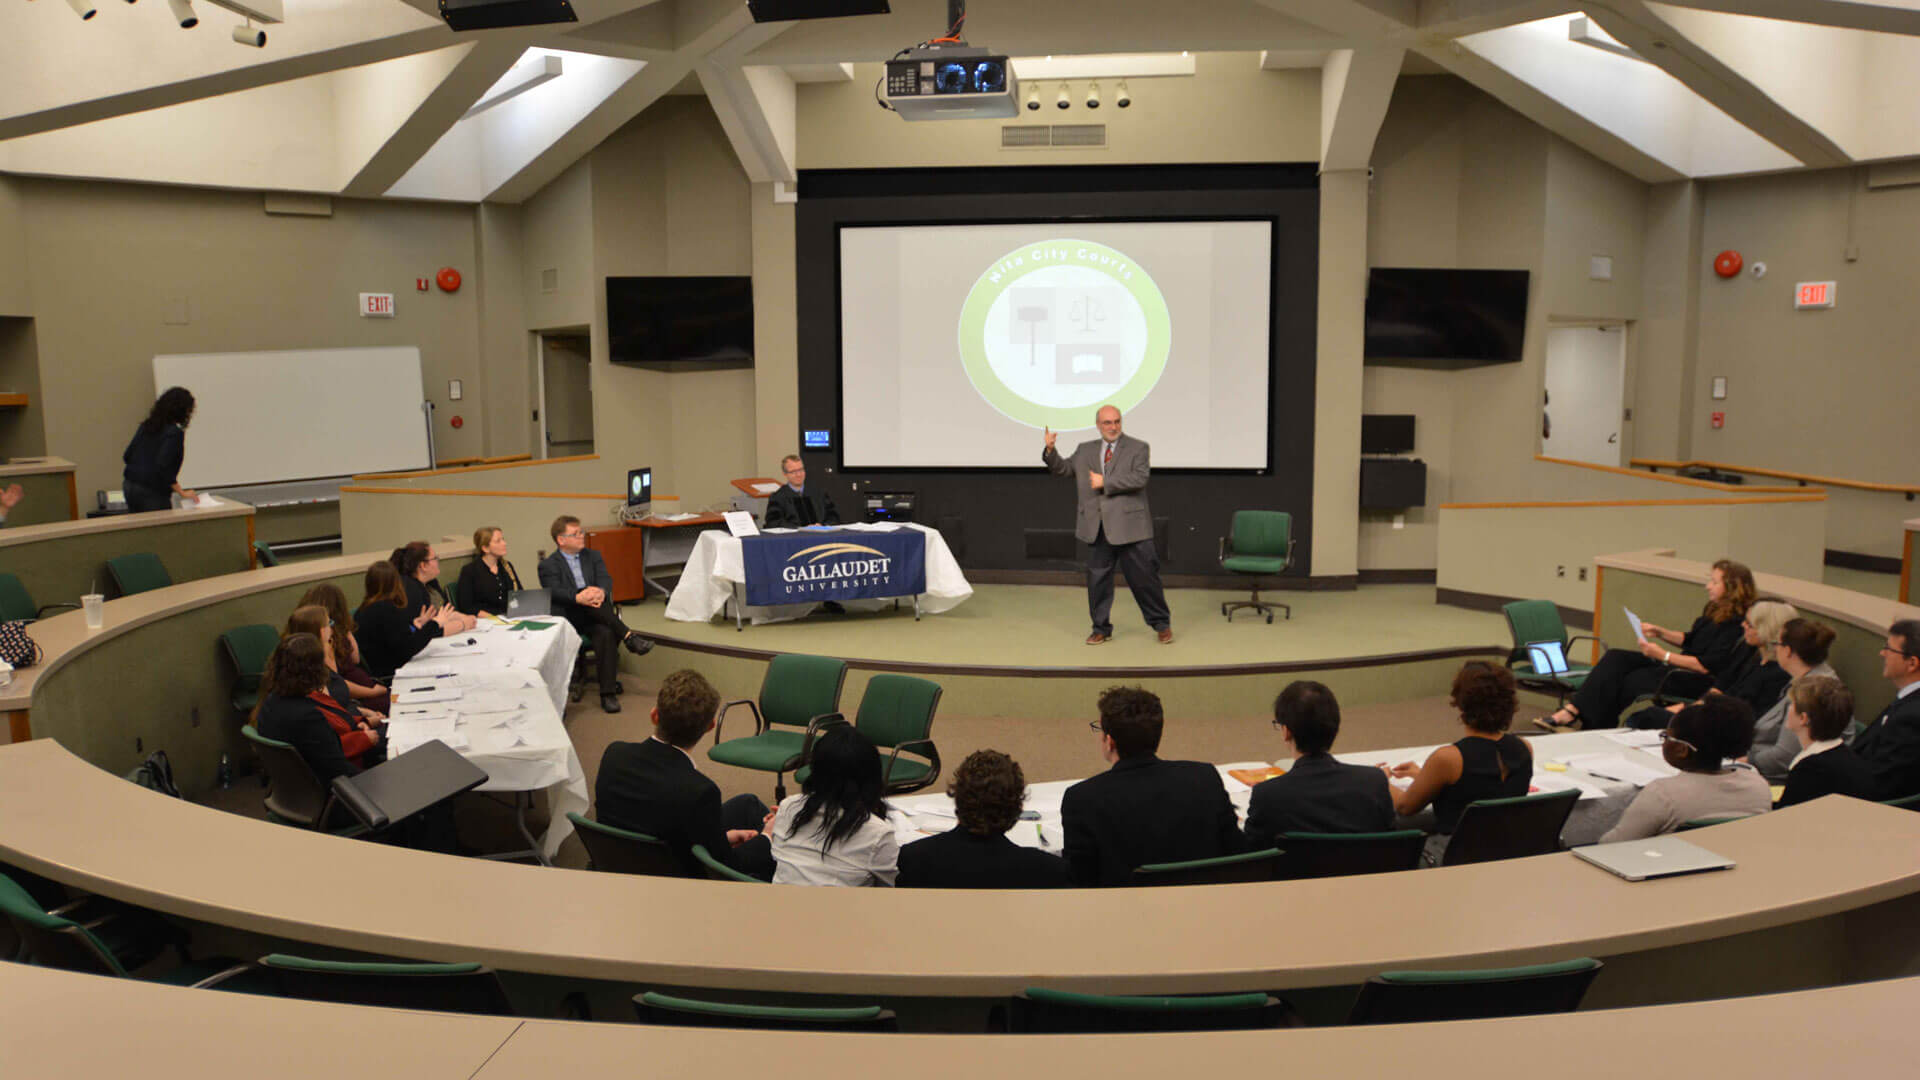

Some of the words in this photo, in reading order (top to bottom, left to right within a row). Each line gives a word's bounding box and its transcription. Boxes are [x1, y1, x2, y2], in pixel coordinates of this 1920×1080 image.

[989, 256, 1024, 284] Nita
[1031, 248, 1068, 261] City
[1077, 248, 1133, 280] Courts
[367, 296, 389, 312] EXIT
[1801, 284, 1827, 305] EXIT
[782, 558, 892, 582] GALLAUDET
[785, 576, 890, 594] UNIVERSITY
